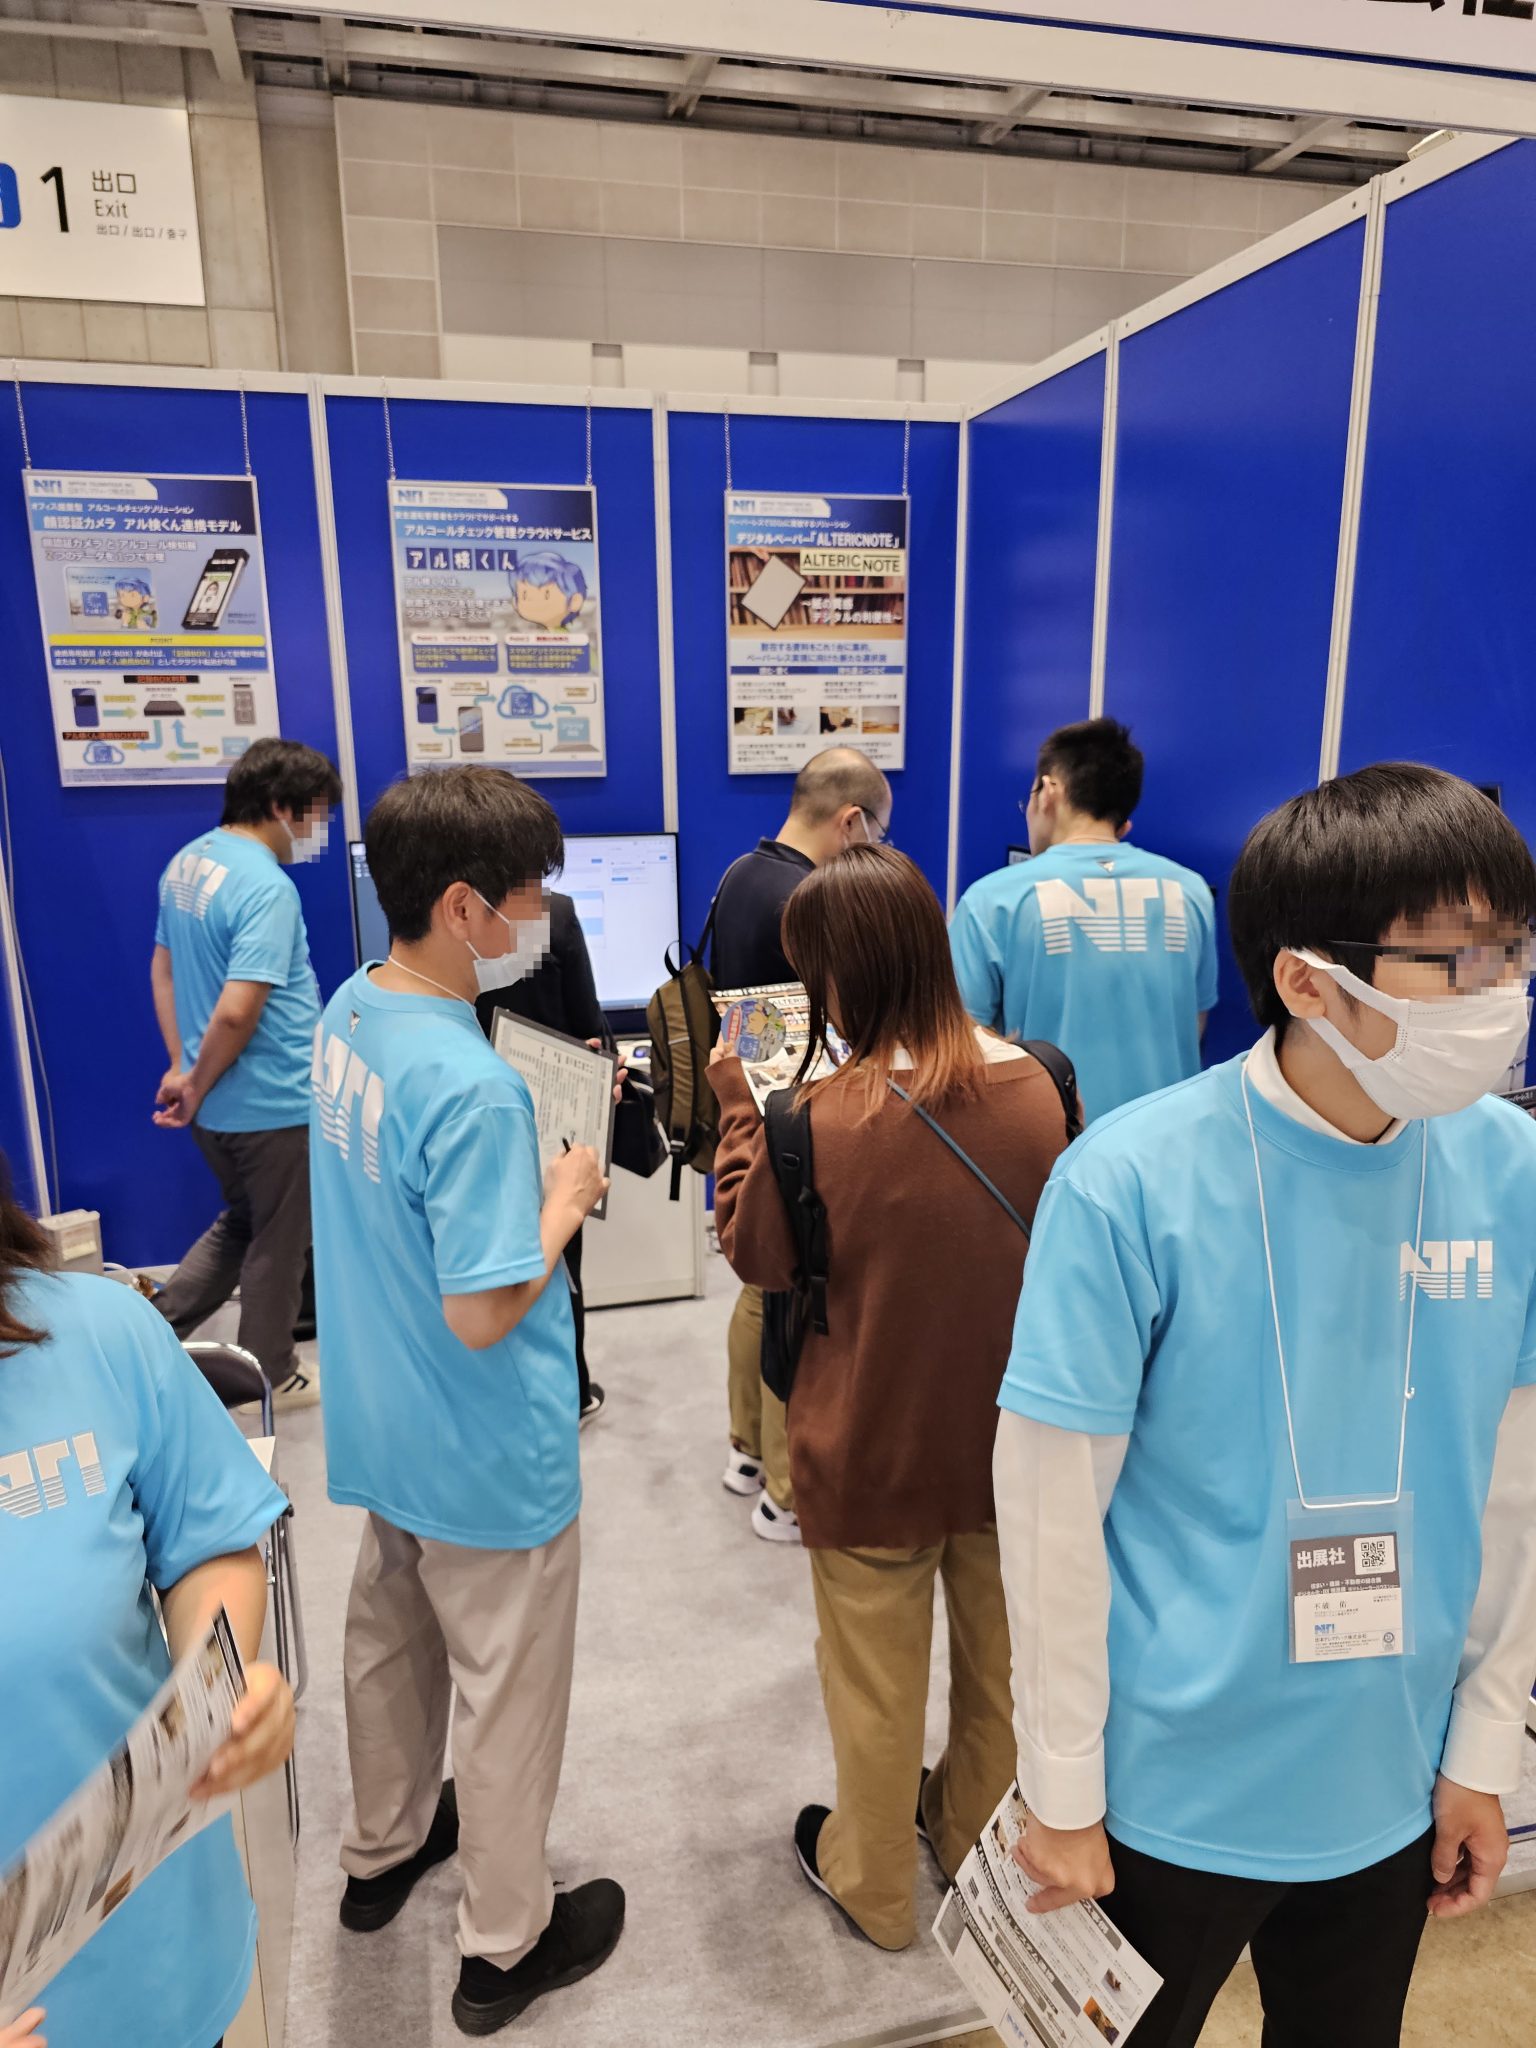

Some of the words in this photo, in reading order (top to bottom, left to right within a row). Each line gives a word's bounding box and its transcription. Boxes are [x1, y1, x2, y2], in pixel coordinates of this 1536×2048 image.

[92, 170, 137, 194] 出口
[40, 166, 70, 233] 1
[94, 199, 129, 219] Exit
[124, 518, 241, 533] アル検くん連携モデル
[404, 525, 592, 541] アルコールチェック管理クラウドサービス
[407, 549, 516, 571] アル検くん
[803, 553, 861, 568] ALTERIC
[863, 559, 900, 573] NOTE
[1034, 877, 1188, 956] NTI
[1399, 1240, 1493, 1301] NTI
[1296, 1547, 1346, 1570] 出展社
